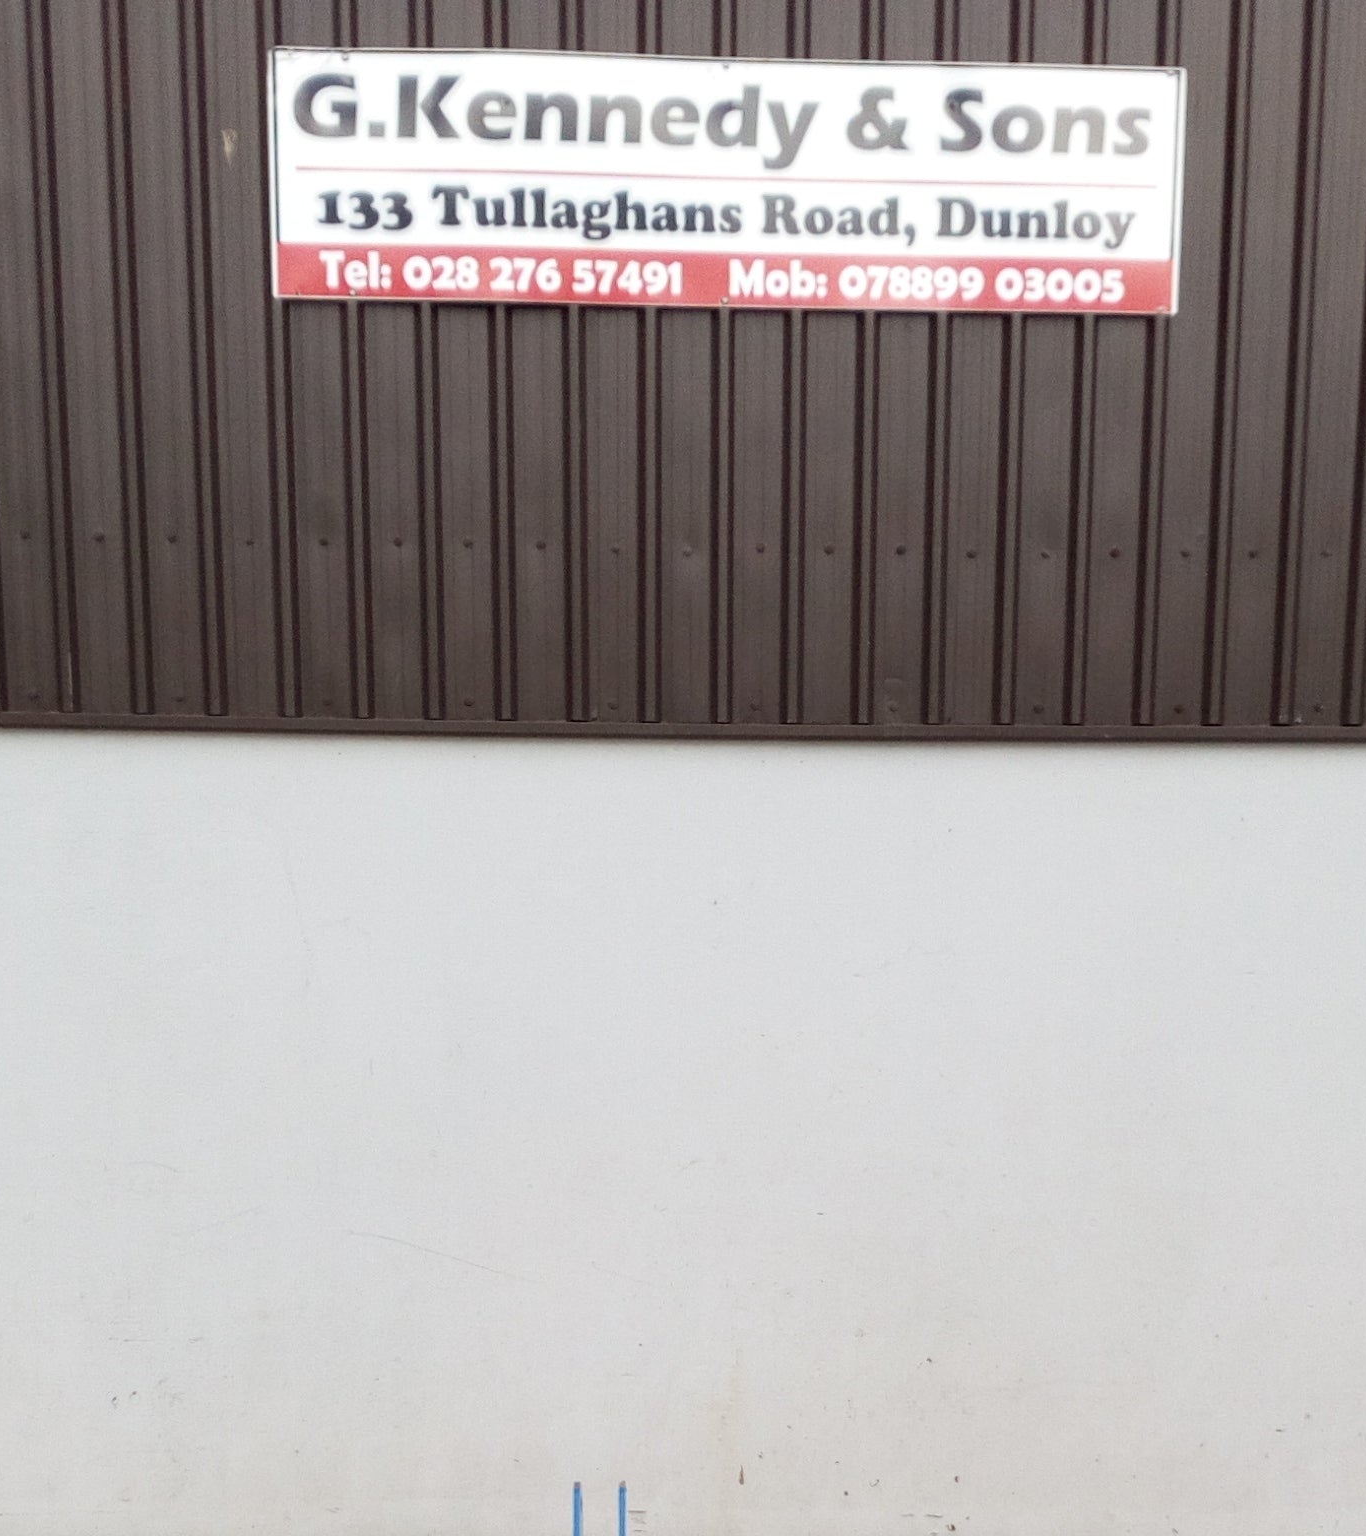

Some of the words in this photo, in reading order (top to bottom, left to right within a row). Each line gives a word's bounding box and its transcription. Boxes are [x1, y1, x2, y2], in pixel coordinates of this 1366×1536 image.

[292, 72, 820, 170] G.Kennedy
[847, 86, 911, 151] &
[939, 88, 1153, 156] Sons
[316, 190, 413, 230] 133
[431, 184, 743, 240] Tullaghans
[761, 193, 916, 246] Road,
[935, 196, 1136, 250] Dunloy
[318, 250, 392, 289] Tel:
[403, 255, 480, 291] 028
[489, 257, 562, 293] 276
[571, 259, 683, 296] 57491
[728, 258, 828, 299] Mob:
[838, 264, 985, 302] 078899
[995, 267, 1126, 303] 03005
